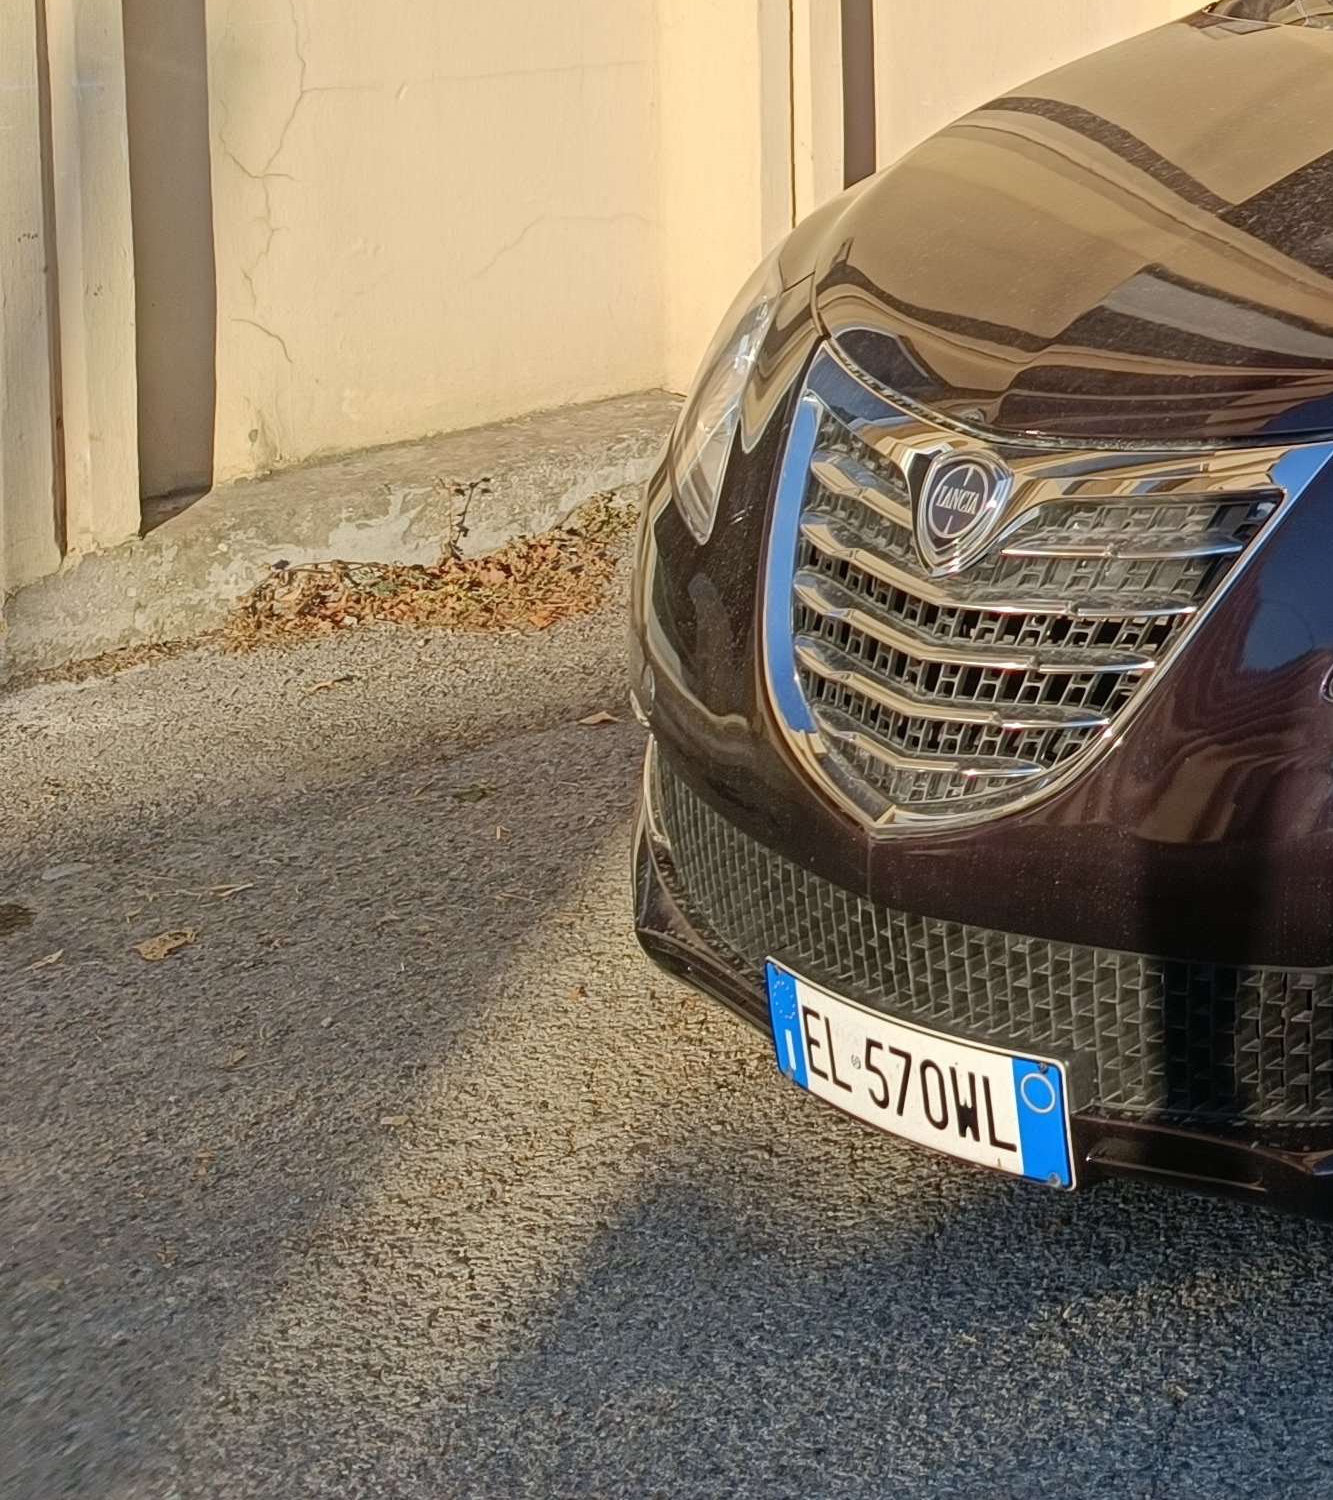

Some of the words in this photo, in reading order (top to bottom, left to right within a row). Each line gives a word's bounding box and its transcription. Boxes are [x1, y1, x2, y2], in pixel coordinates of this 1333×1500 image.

[935, 485, 980, 515] LANCIA
[802, 1005, 852, 1093] EL
[864, 1038, 1018, 1153] 570WL
